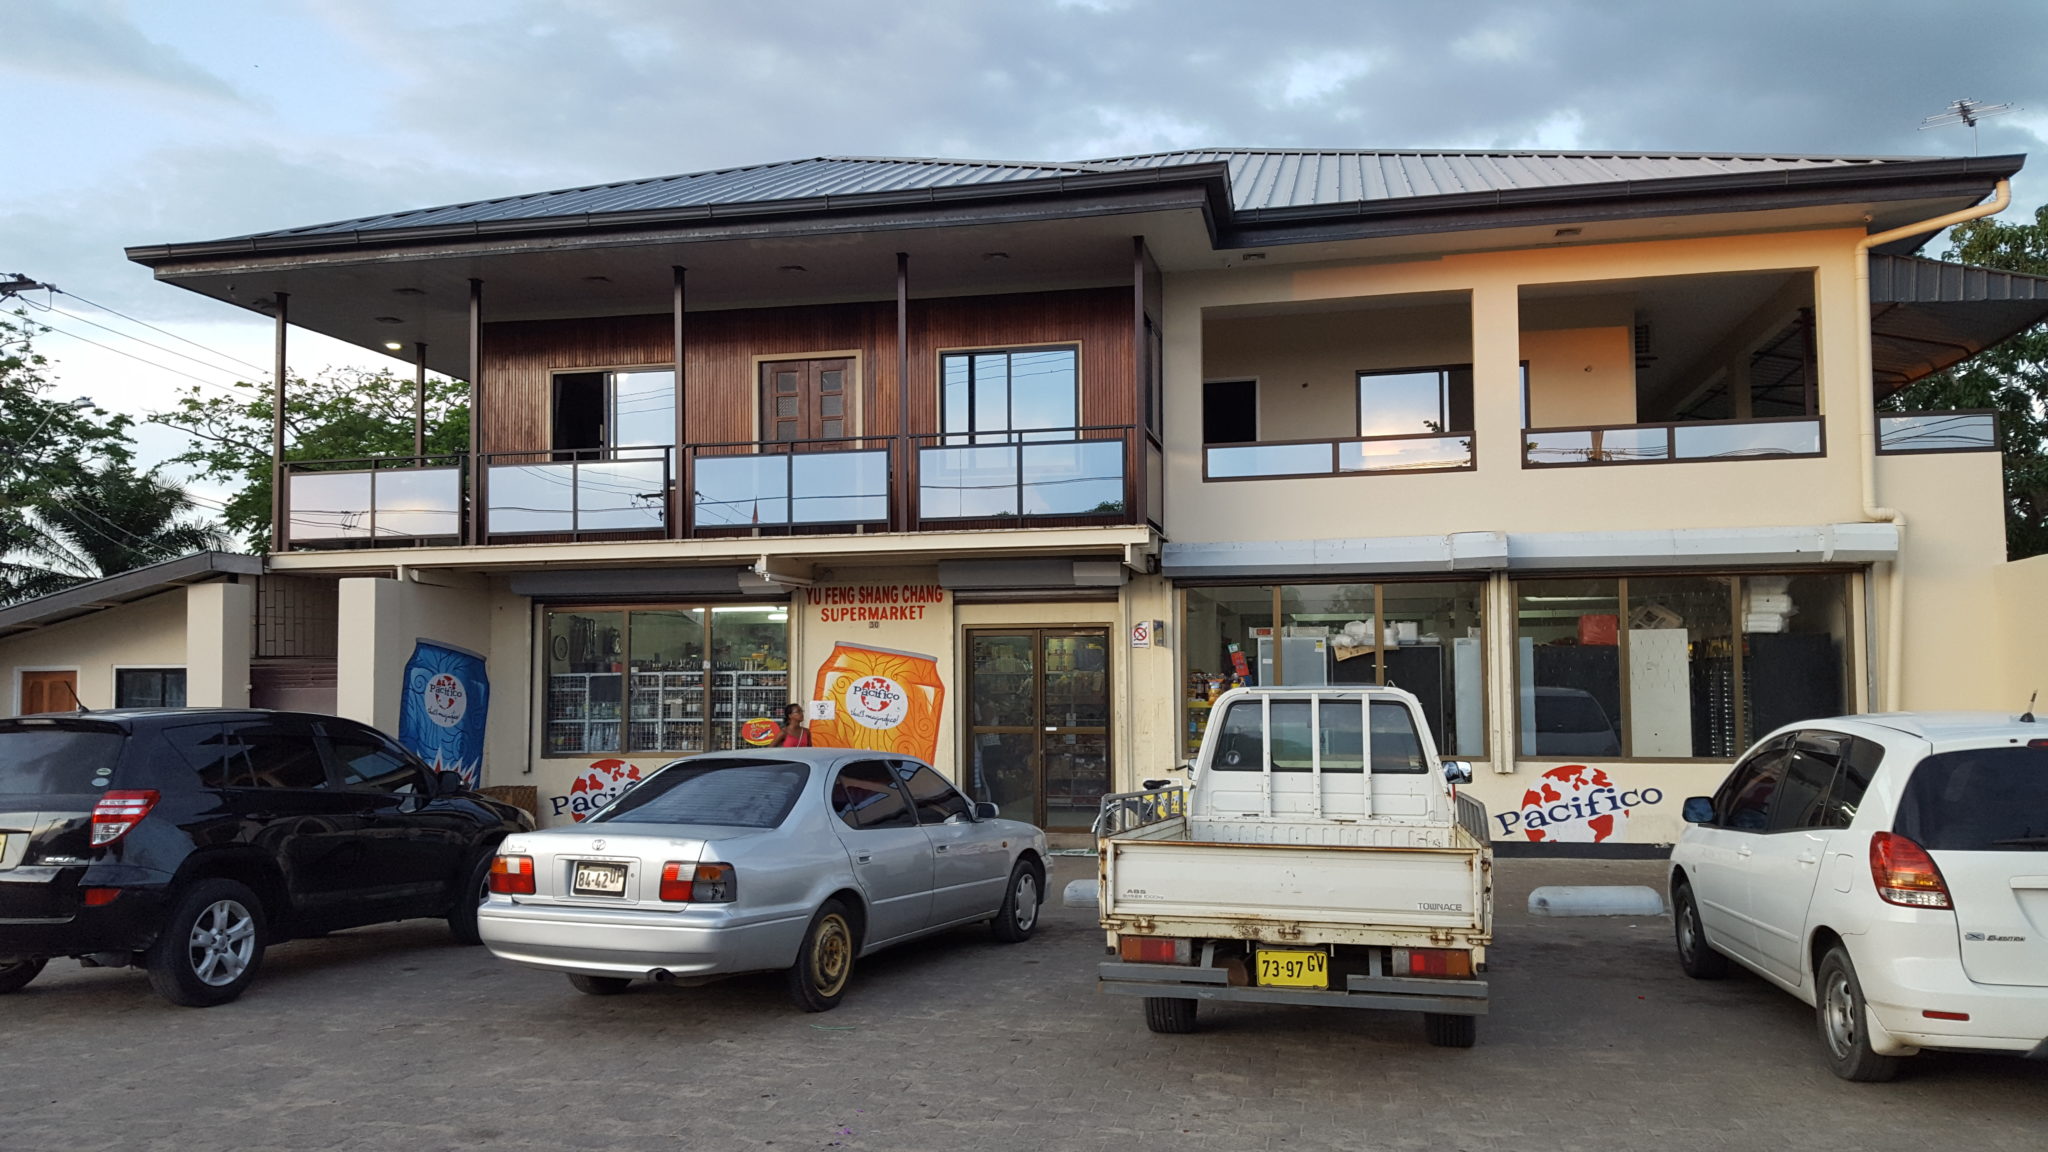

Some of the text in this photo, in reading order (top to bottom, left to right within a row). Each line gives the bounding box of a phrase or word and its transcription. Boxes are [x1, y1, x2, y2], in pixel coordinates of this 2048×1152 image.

[806, 584, 943, 605] YU FENG SHANG CHANG
[820, 605, 926, 622] SUPERMARKET
[429, 684, 463, 698] Pacifico
[853, 686, 900, 701] Pacifico
[1494, 787, 1663, 836] Pacifico
[1417, 902, 1463, 912] TOWNACE
[1262, 955, 1325, 979] 73-97 GV
